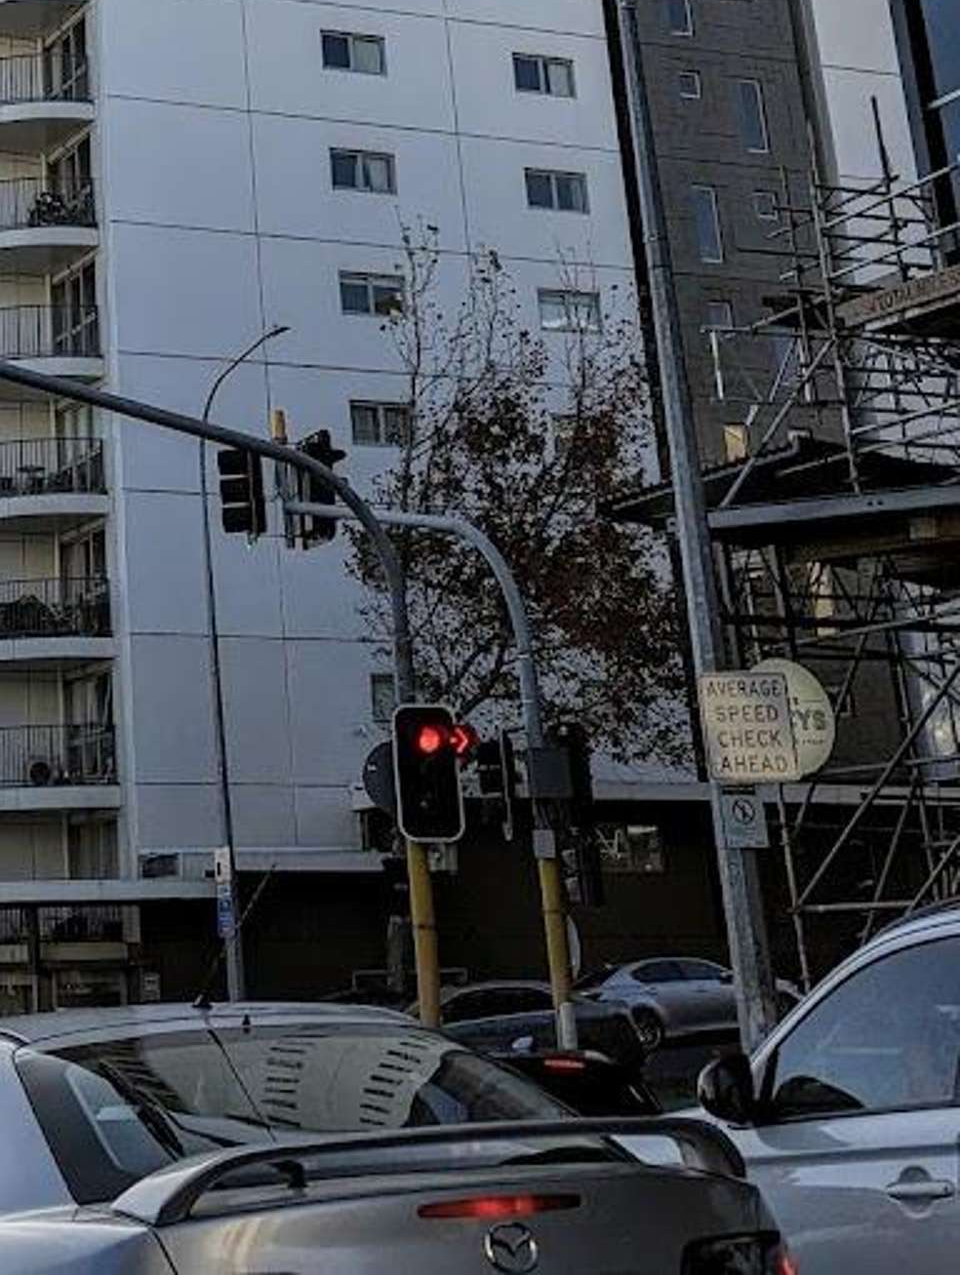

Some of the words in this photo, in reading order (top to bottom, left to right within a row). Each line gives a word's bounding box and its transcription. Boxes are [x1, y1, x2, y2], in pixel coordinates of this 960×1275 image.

[706, 678, 781, 698] AVERAGE
[715, 704, 779, 723] SPEED
[792, 708, 827, 731] YS
[718, 729, 783, 748] CHECK
[720, 754, 789, 774] AHEAD
